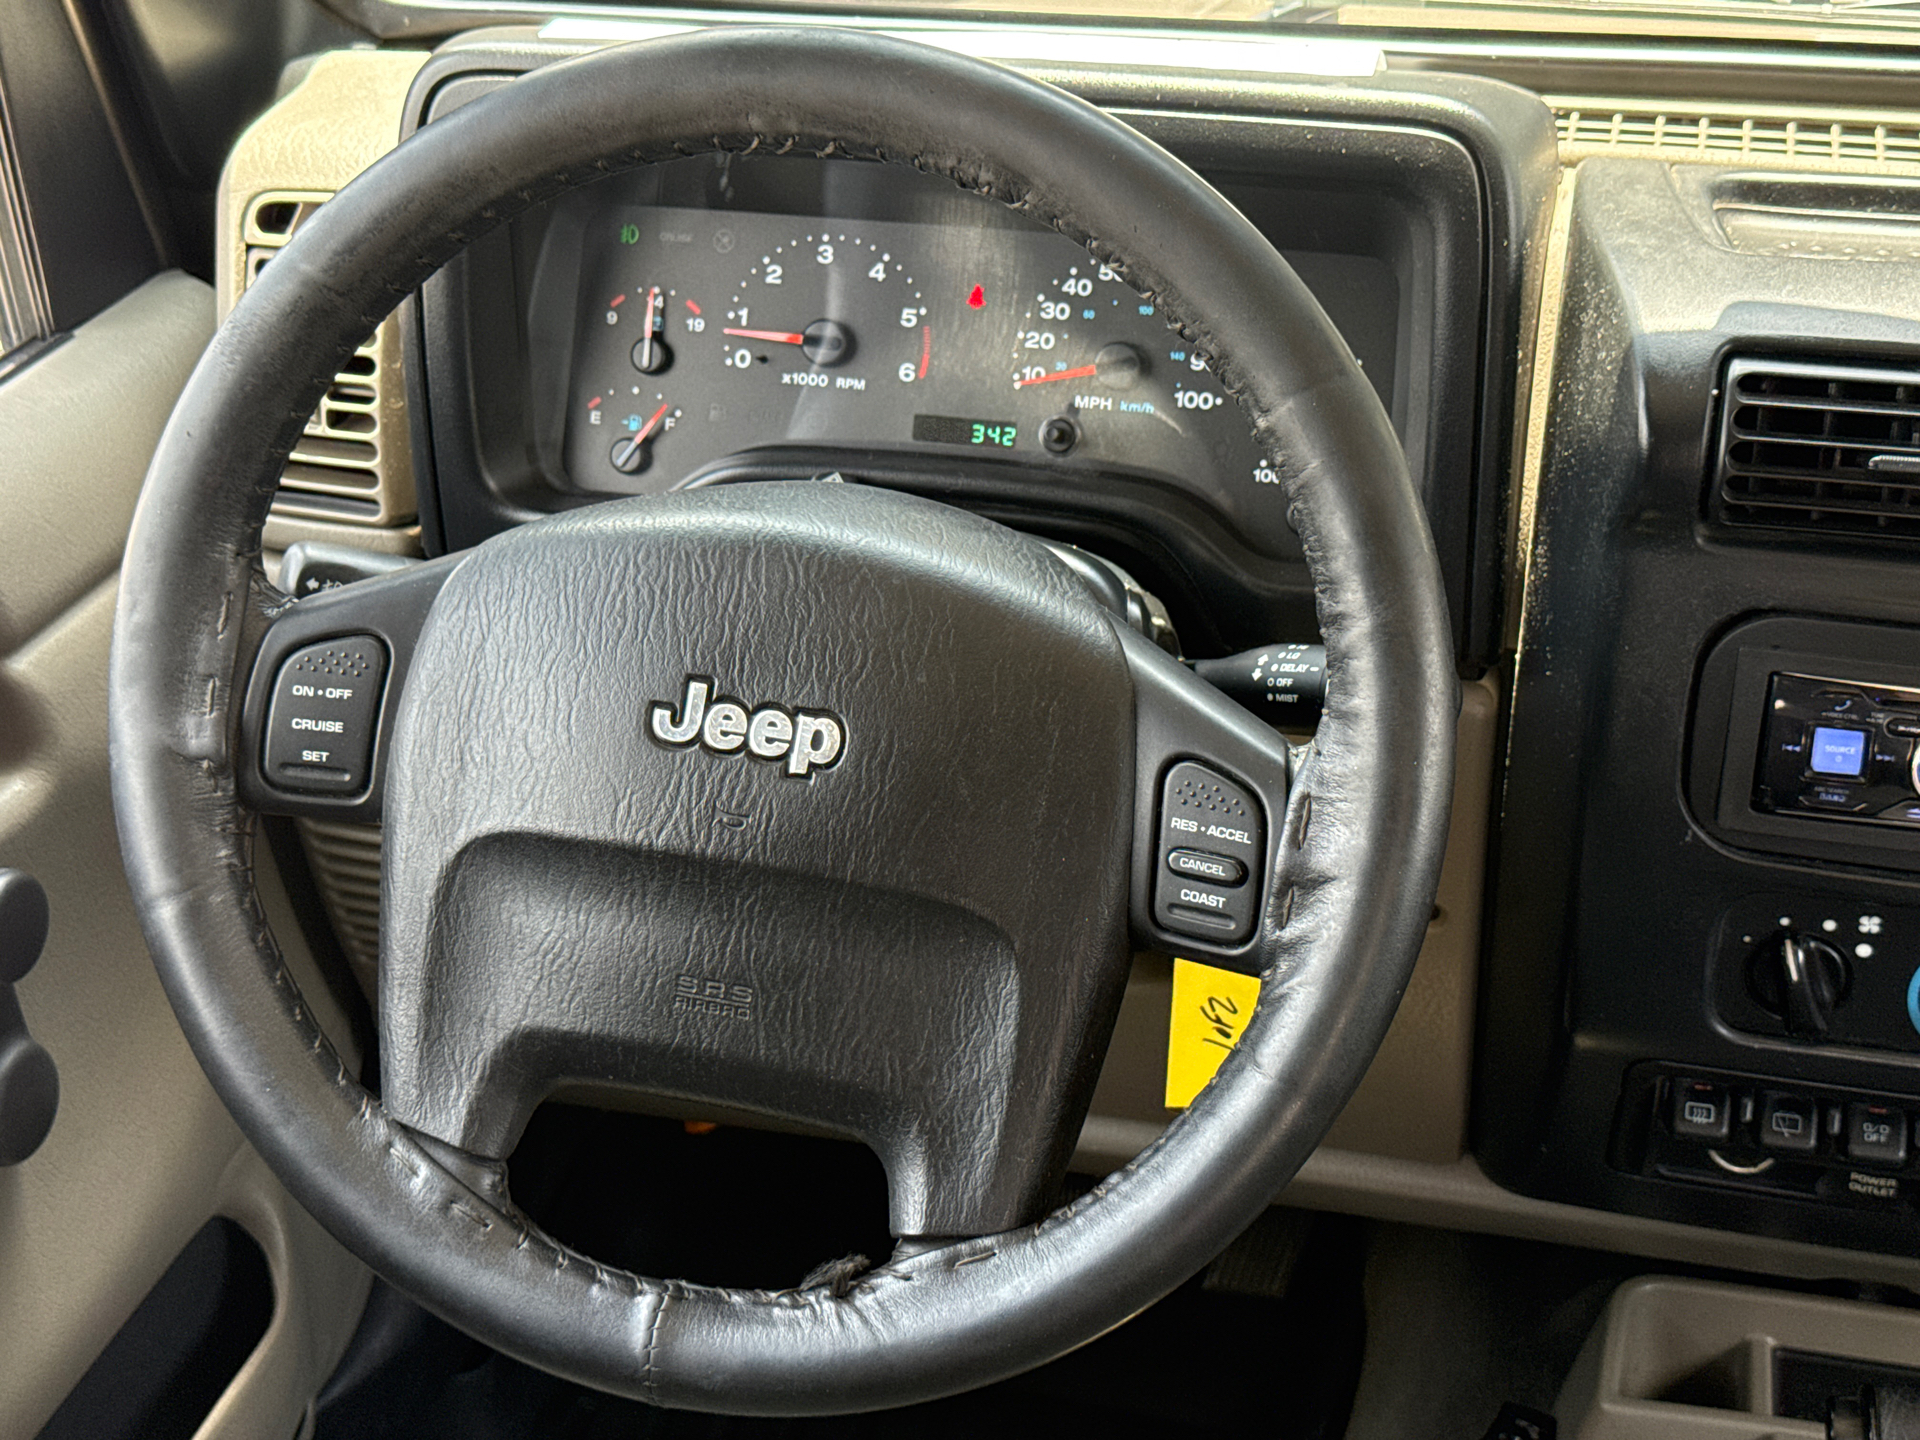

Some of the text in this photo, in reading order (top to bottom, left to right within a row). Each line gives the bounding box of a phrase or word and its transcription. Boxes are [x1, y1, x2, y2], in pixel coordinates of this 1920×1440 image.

[816, 244, 835, 265] 3
[764, 265, 783, 285] 2
[868, 262, 887, 282] 4
[1061, 277, 1093, 297] 40
[606, 310, 618, 325] 9
[737, 307, 749, 327] 1
[900, 307, 918, 328] 5
[1039, 301, 1071, 321] 30
[1138, 305, 1155, 316] 100
[686, 317, 706, 333] 19
[1024, 331, 1056, 350] 20
[734, 348, 752, 369] 0
[898, 362, 916, 383] 6
[1021, 365, 1046, 383] 10
[835, 376, 866, 391] RPM
[1074, 394, 1155, 414] MPH km/h
[1174, 390, 1214, 410] 100
[590, 411, 601, 425] E
[664, 417, 676, 431] F
[971, 423, 1017, 447] 342
[1285, 652, 1302, 660] LO
[1279, 663, 1310, 673] DELAY
[1275, 677, 1294, 688] OFF
[291, 684, 354, 701] ON OFF
[1275, 693, 1299, 703] MIST
[291, 717, 344, 733] CRUISE
[650, 678, 845, 778] Jeep
[301, 749, 331, 763] SET
[1824, 744, 1857, 756] SOURCE
[1170, 816, 1253, 845] RES ACCEL
[1179, 857, 1226, 877] CANCEL
[1180, 888, 1227, 909] COAST
[1863, 1132, 1888, 1143] OFF
[1850, 1171, 1898, 1189] POWER
[1848, 1181, 1898, 1198] OUTLET
